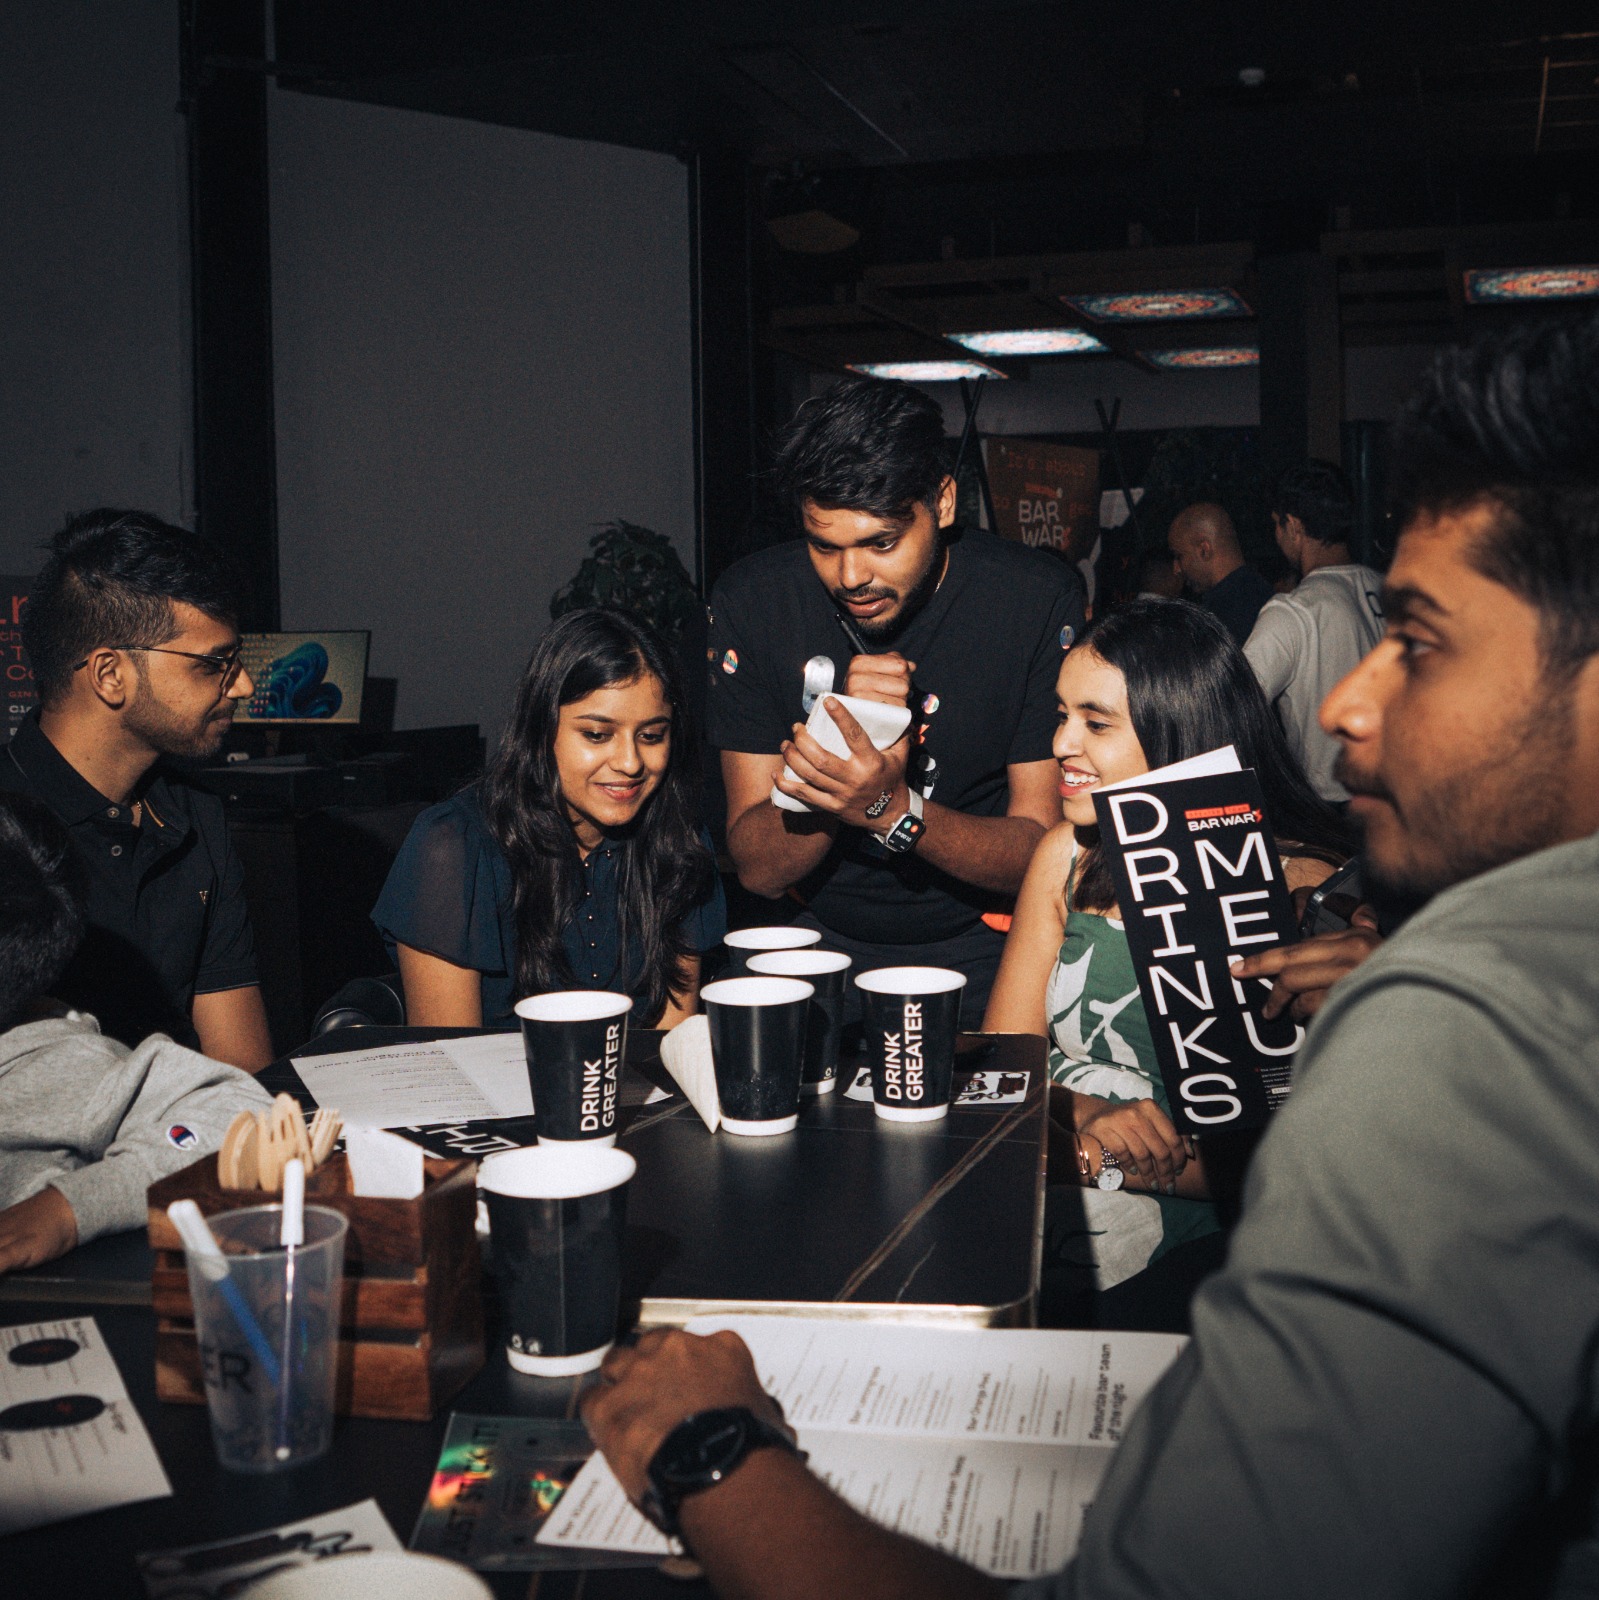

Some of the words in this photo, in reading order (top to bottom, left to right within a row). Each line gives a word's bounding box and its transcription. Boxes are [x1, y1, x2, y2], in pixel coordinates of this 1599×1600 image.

[1018, 500, 1060, 523] BAR
[1021, 525, 1065, 548] WAR
[1187, 817, 1221, 832] BAR
[1220, 812, 1255, 827] WAR
[1107, 791, 1243, 1125] DRINKS
[885, 1031, 901, 1100] DRINK
[905, 1002, 923, 1101] GREATER
[601, 1022, 620, 1128] GREATER
[581, 1058, 602, 1132] DRINK
[1099, 1343, 1111, 1372] team
[1096, 1372, 1108, 1393] bar
[1111, 1383, 1127, 1410] night
[1088, 1393, 1106, 1440] Favourite
